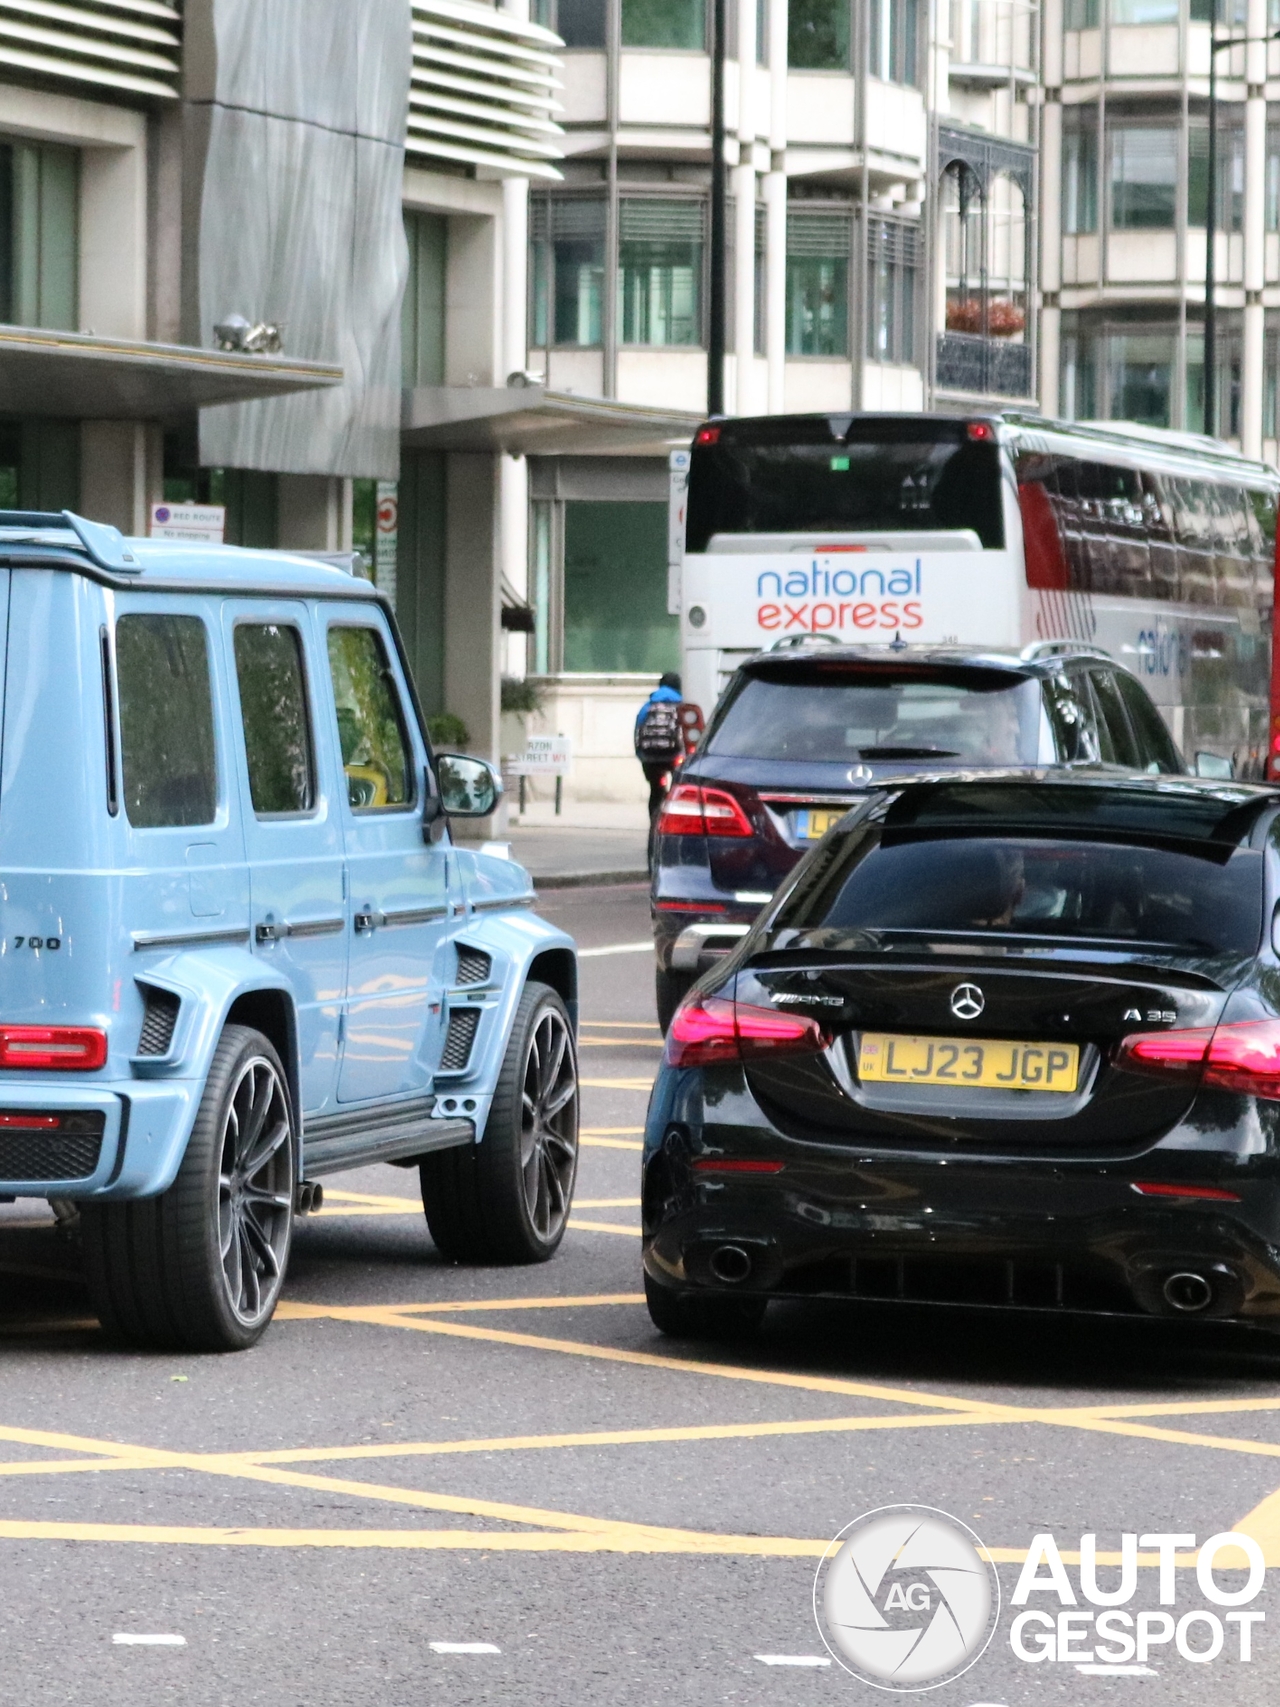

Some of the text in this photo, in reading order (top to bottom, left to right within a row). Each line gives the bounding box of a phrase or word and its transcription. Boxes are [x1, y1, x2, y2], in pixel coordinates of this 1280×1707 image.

[173, 512, 221, 521] RED ROUTE
[163, 530, 211, 540] No stopping
[757, 558, 921, 597] national
[757, 602, 923, 641] express
[14, 936, 61, 950] 700
[1123, 1008, 1177, 1023] A 35
[862, 1062, 875, 1072] UK
[886, 1041, 1069, 1084] LJ23 JGP
